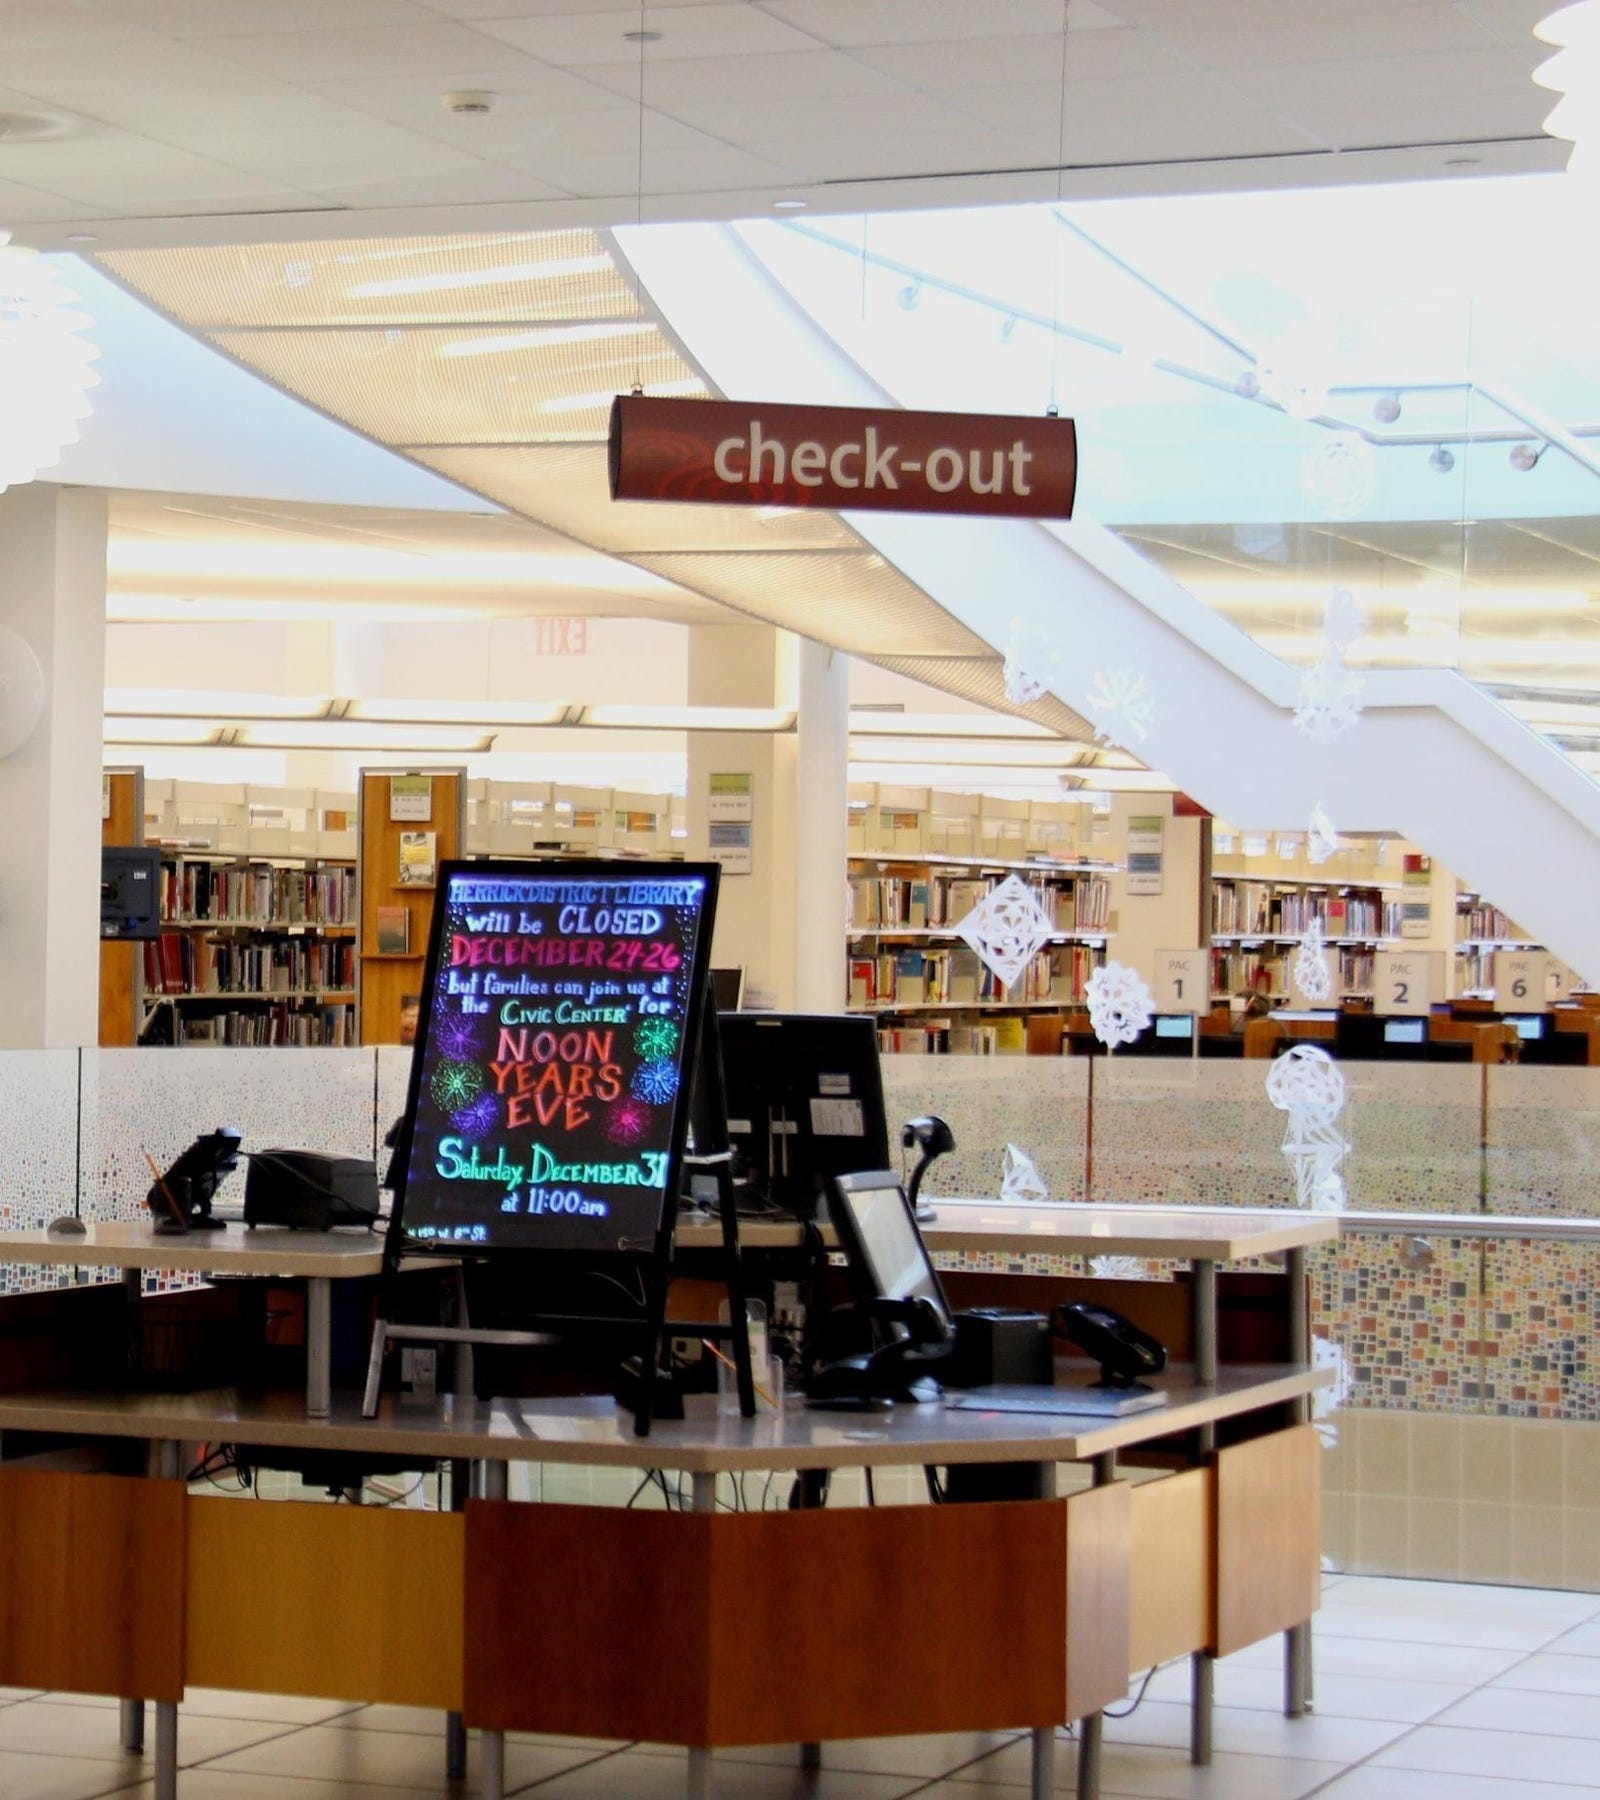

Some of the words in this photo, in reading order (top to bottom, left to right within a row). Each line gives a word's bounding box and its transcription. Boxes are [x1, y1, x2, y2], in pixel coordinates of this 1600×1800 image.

[713, 420, 1033, 497] check-out
[133, 872, 147, 880] IBM
[450, 883, 525, 903] HERRICK
[613, 884, 700, 905] LIBRARY
[465, 912, 510, 933] will
[517, 912, 542, 934] be
[558, 905, 664, 935] CLOSED
[451, 936, 606, 967] DECEMBER
[1168, 960, 1191, 971] PAC
[1390, 964, 1413, 975] PAC
[1509, 960, 1528, 972] PAC
[448, 972, 479, 995] but
[483, 974, 548, 995] families
[553, 980, 584, 995] can
[585, 981, 621, 1004] join
[626, 981, 646, 995] us
[651, 977, 670, 995] at
[1172, 979, 1183, 999] 1
[1393, 982, 1408, 1003] 2
[1512, 979, 1527, 998] 6
[461, 996, 489, 1014] the
[638, 995, 672, 1014] for
[496, 1028, 615, 1063] NOON
[489, 1062, 623, 1101] YEARS
[506, 1093, 591, 1131] EVE
[501, 1192, 520, 1213] at
